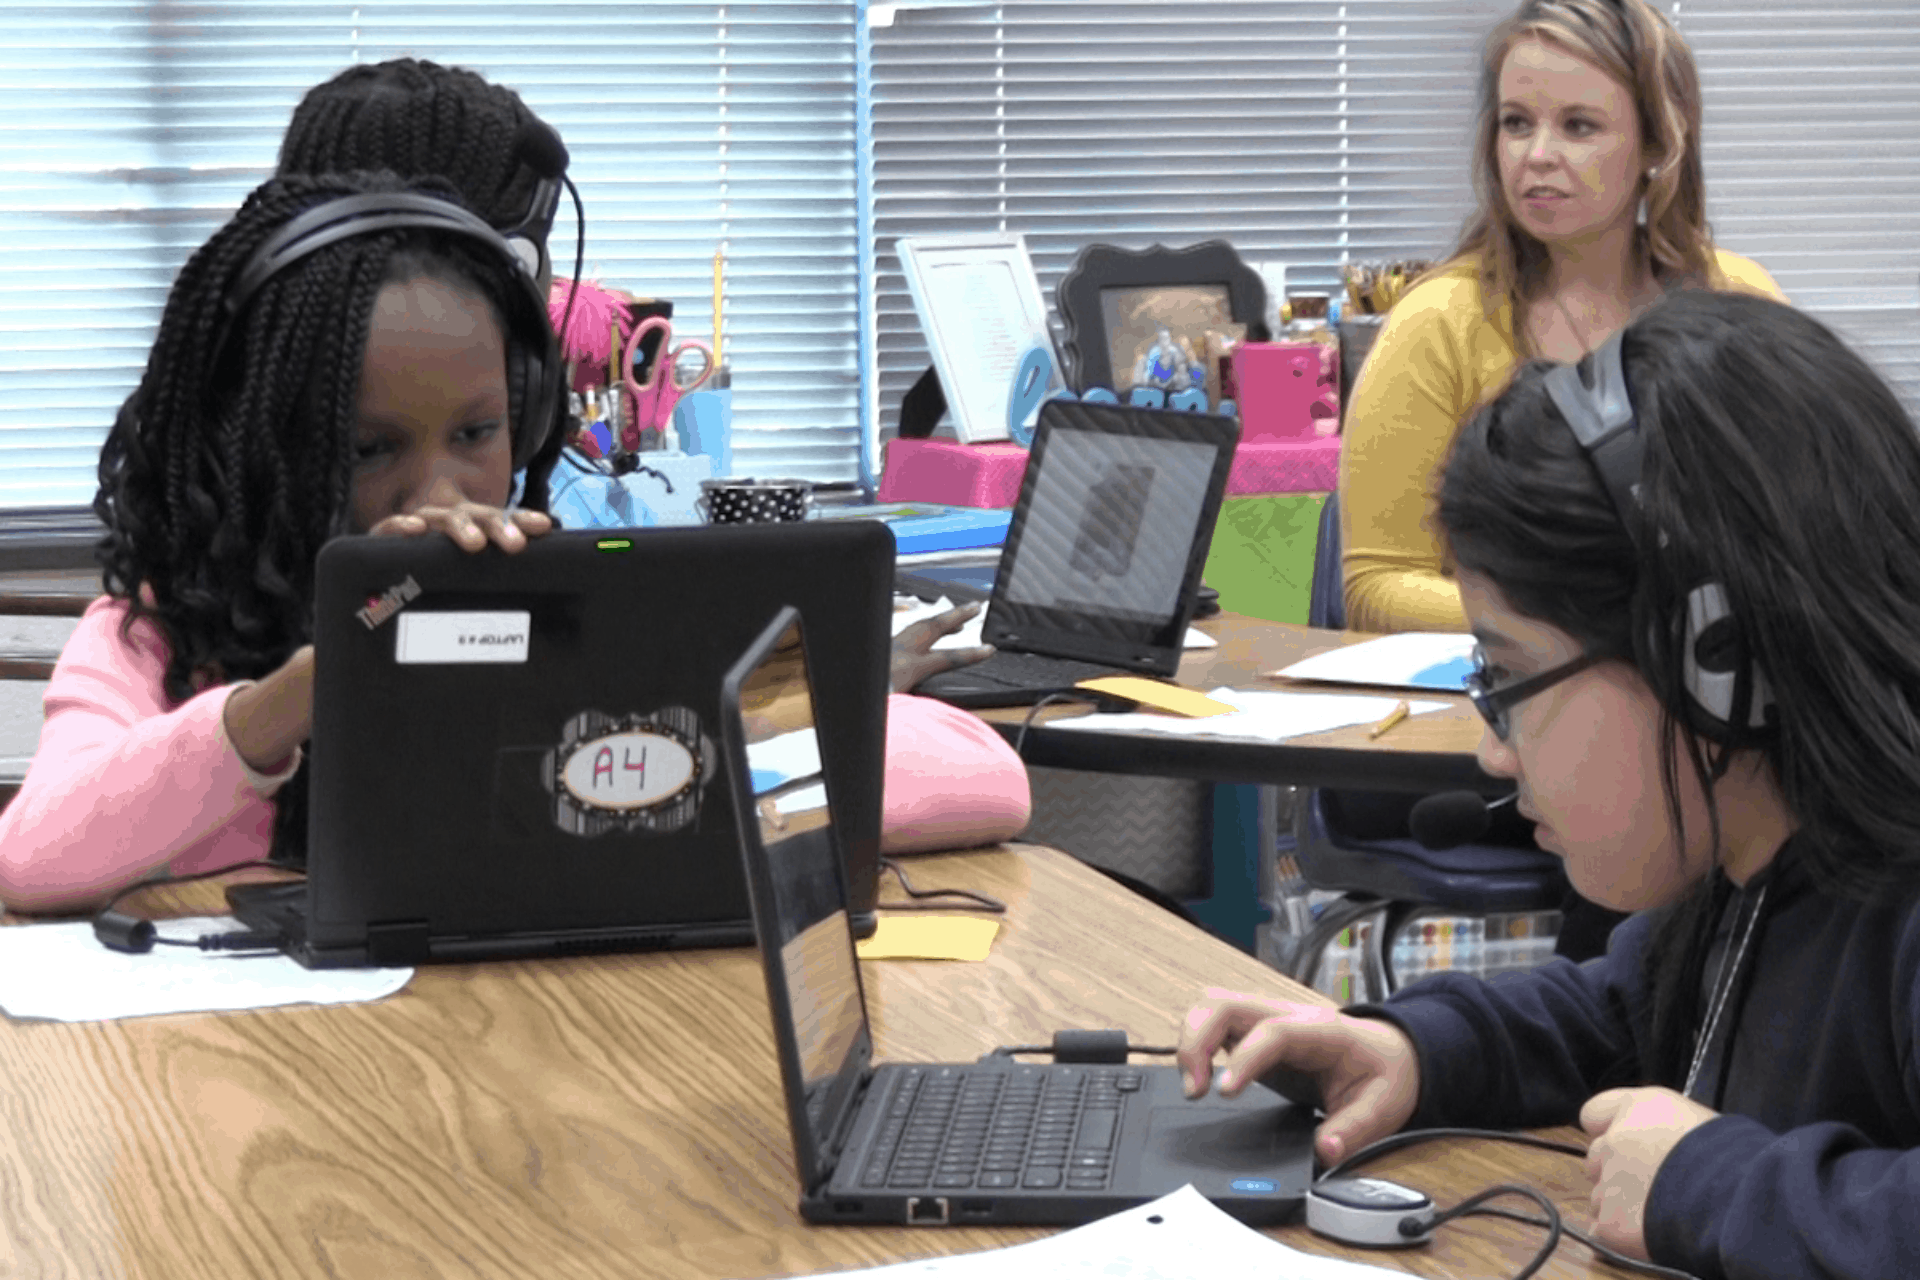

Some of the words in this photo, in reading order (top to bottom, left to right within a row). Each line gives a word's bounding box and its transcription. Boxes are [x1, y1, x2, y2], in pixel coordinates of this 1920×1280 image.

[355, 574, 422, 630] ThinkPad
[478, 634, 525, 646] LAPTOP
[592, 744, 647, 790] A4
